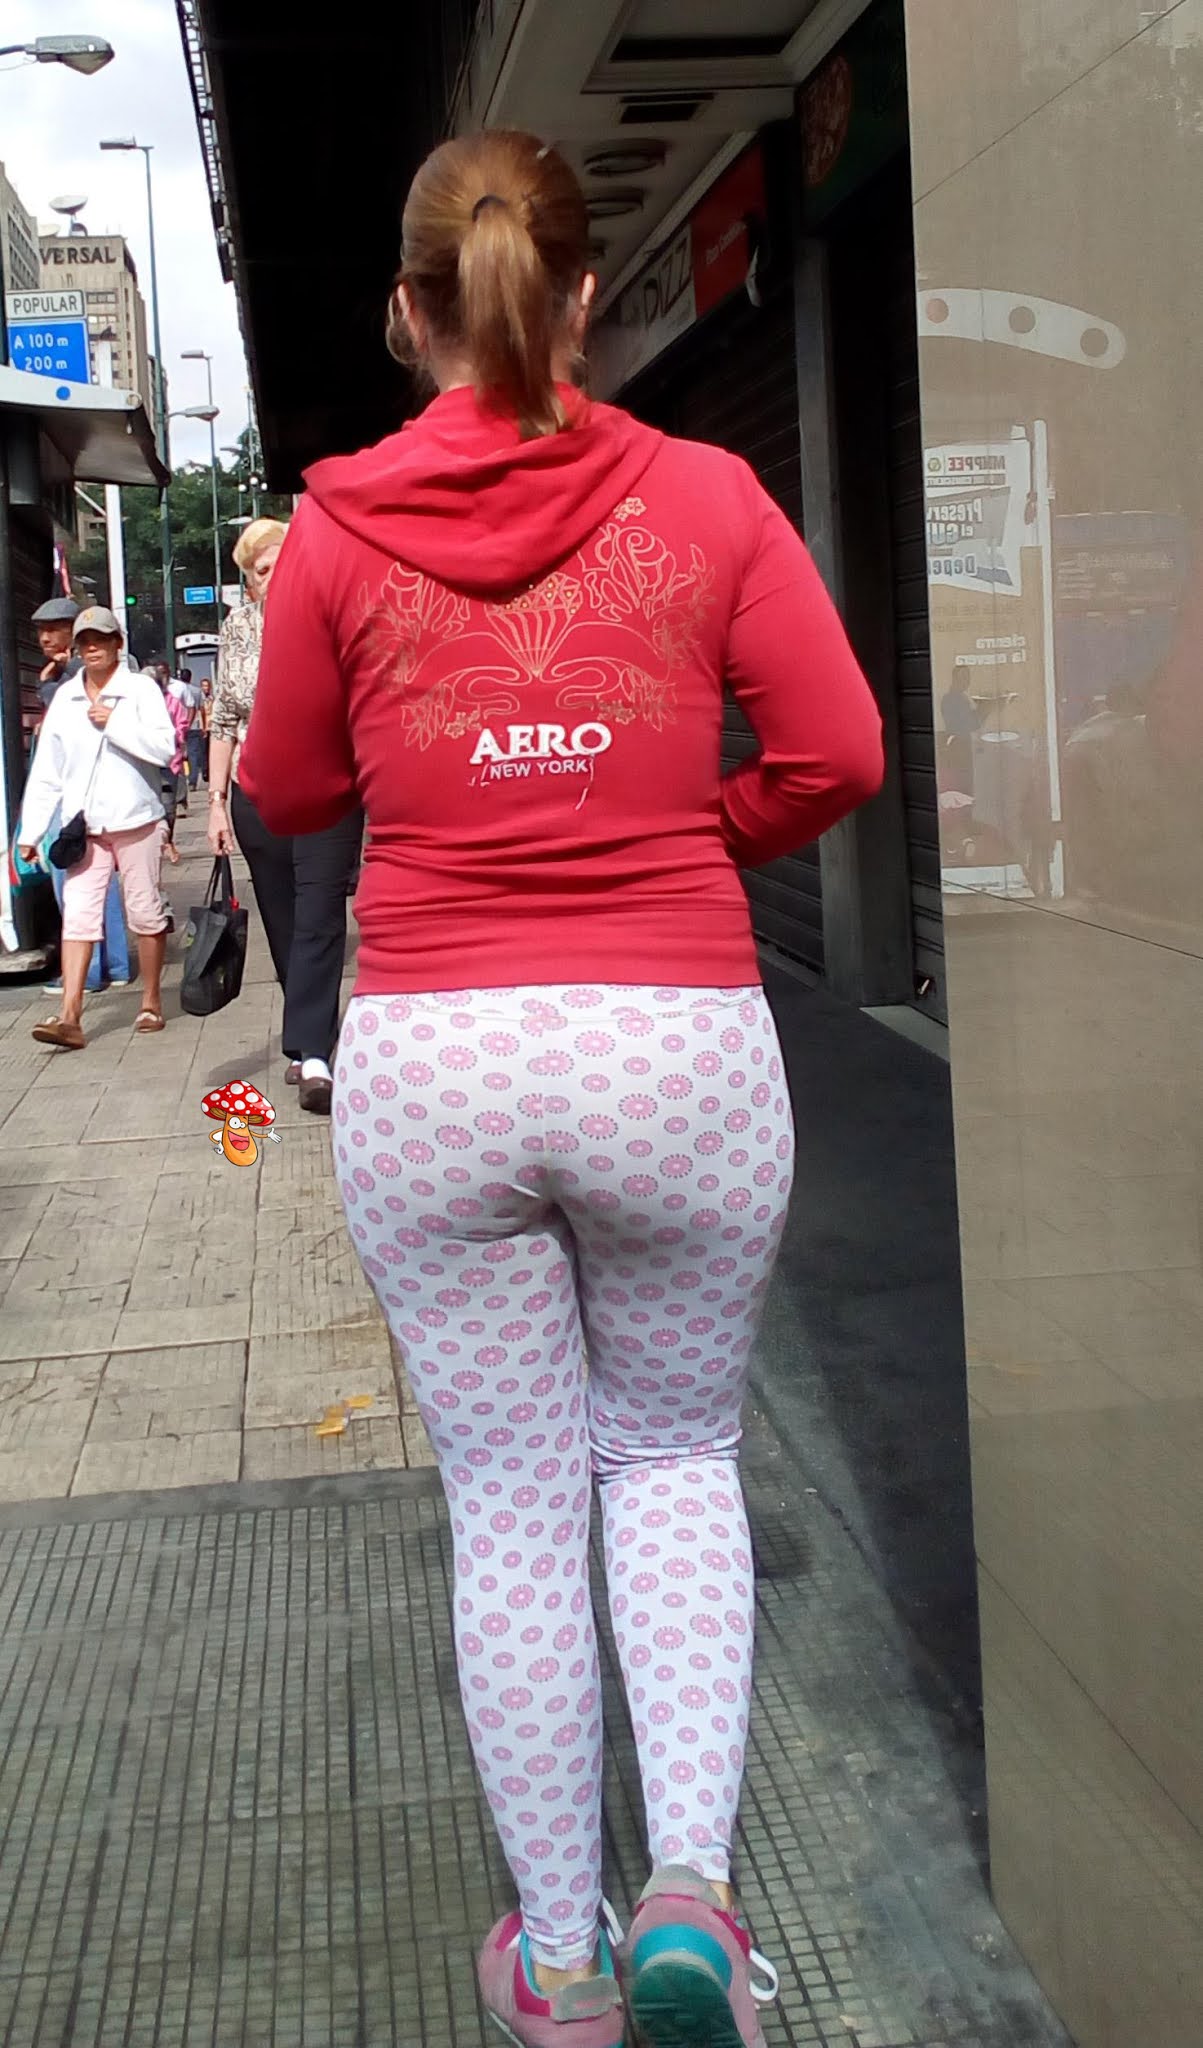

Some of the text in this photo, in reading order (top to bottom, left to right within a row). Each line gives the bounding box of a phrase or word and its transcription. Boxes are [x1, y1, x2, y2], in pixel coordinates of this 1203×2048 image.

[40, 246, 117, 266] VERSAL
[13, 295, 78, 315] POPULAR
[14, 333, 69, 350] A 100 m
[25, 356, 68, 372] 200 m
[469, 722, 612, 764] AERO
[490, 759, 589, 779] NEW YORK
